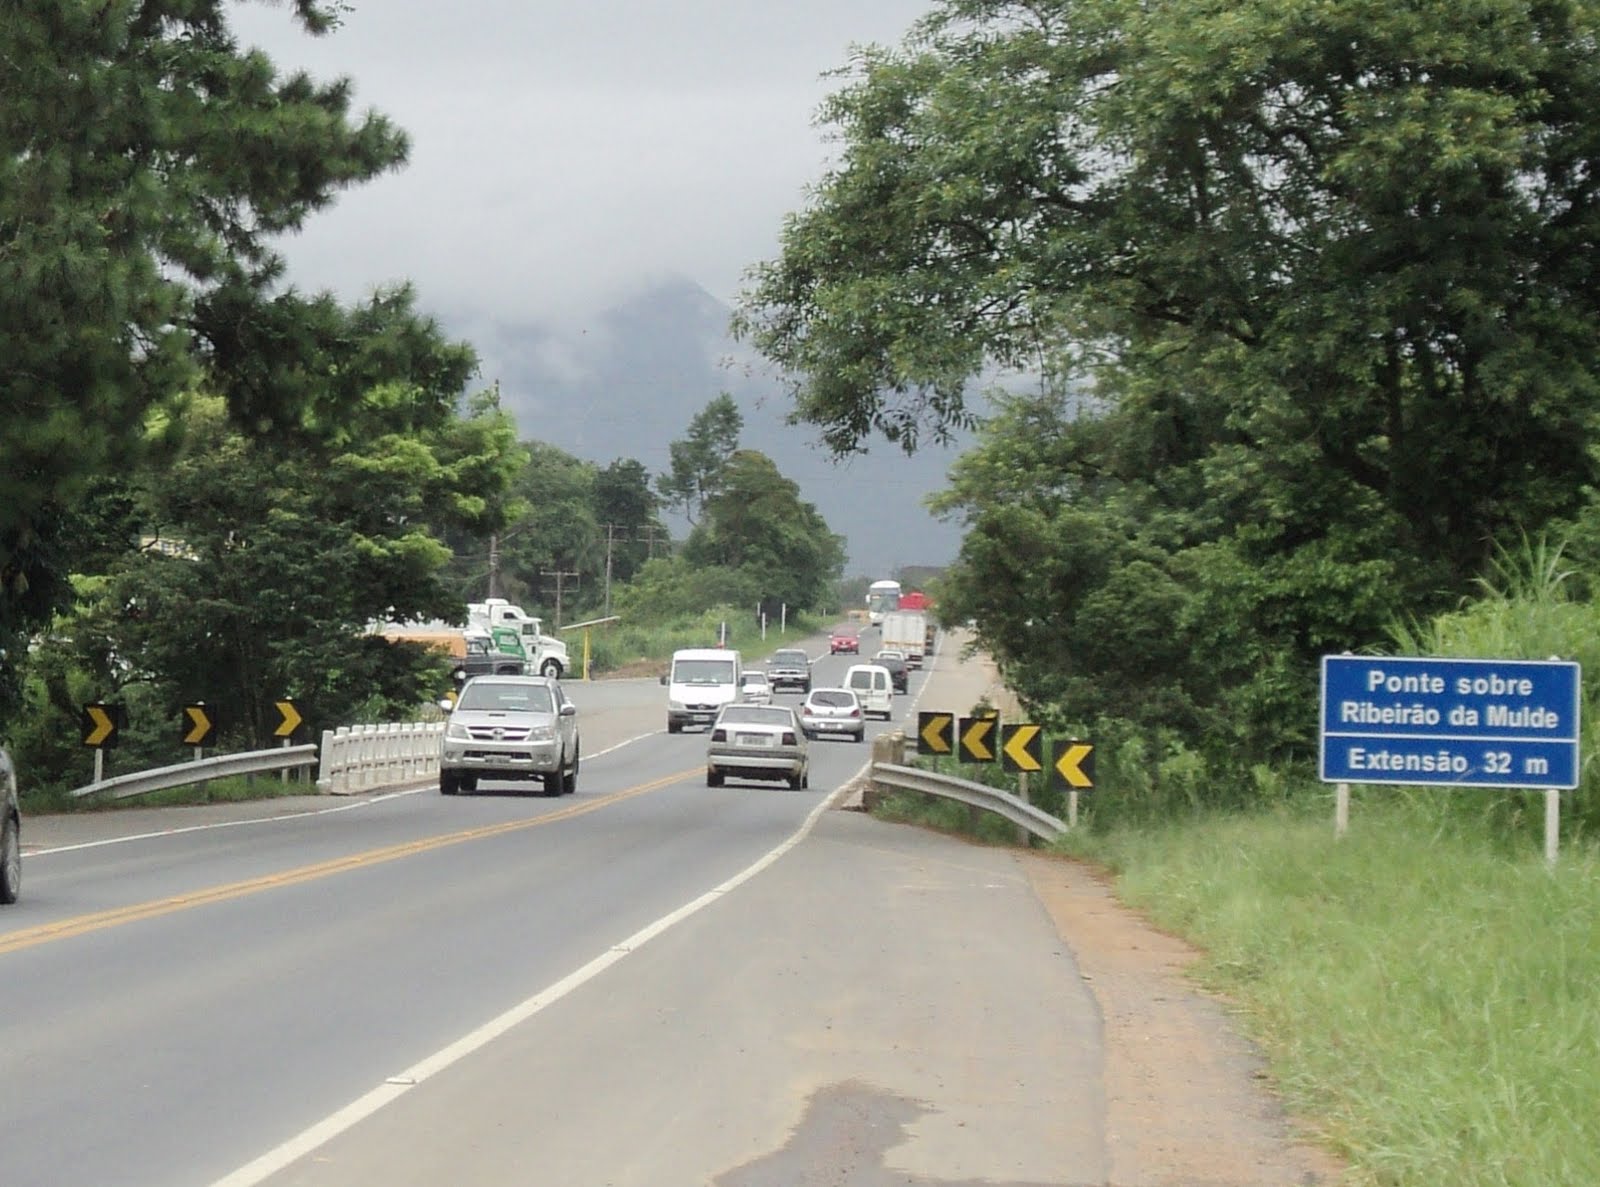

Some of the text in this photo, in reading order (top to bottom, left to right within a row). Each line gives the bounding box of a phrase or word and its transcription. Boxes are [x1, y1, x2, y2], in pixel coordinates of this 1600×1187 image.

[1367, 670, 1533, 696] Ponte sobre
[1341, 701, 1559, 729] Ribeirão da Mulde
[1349, 748, 1549, 775] Extensão 32 m
